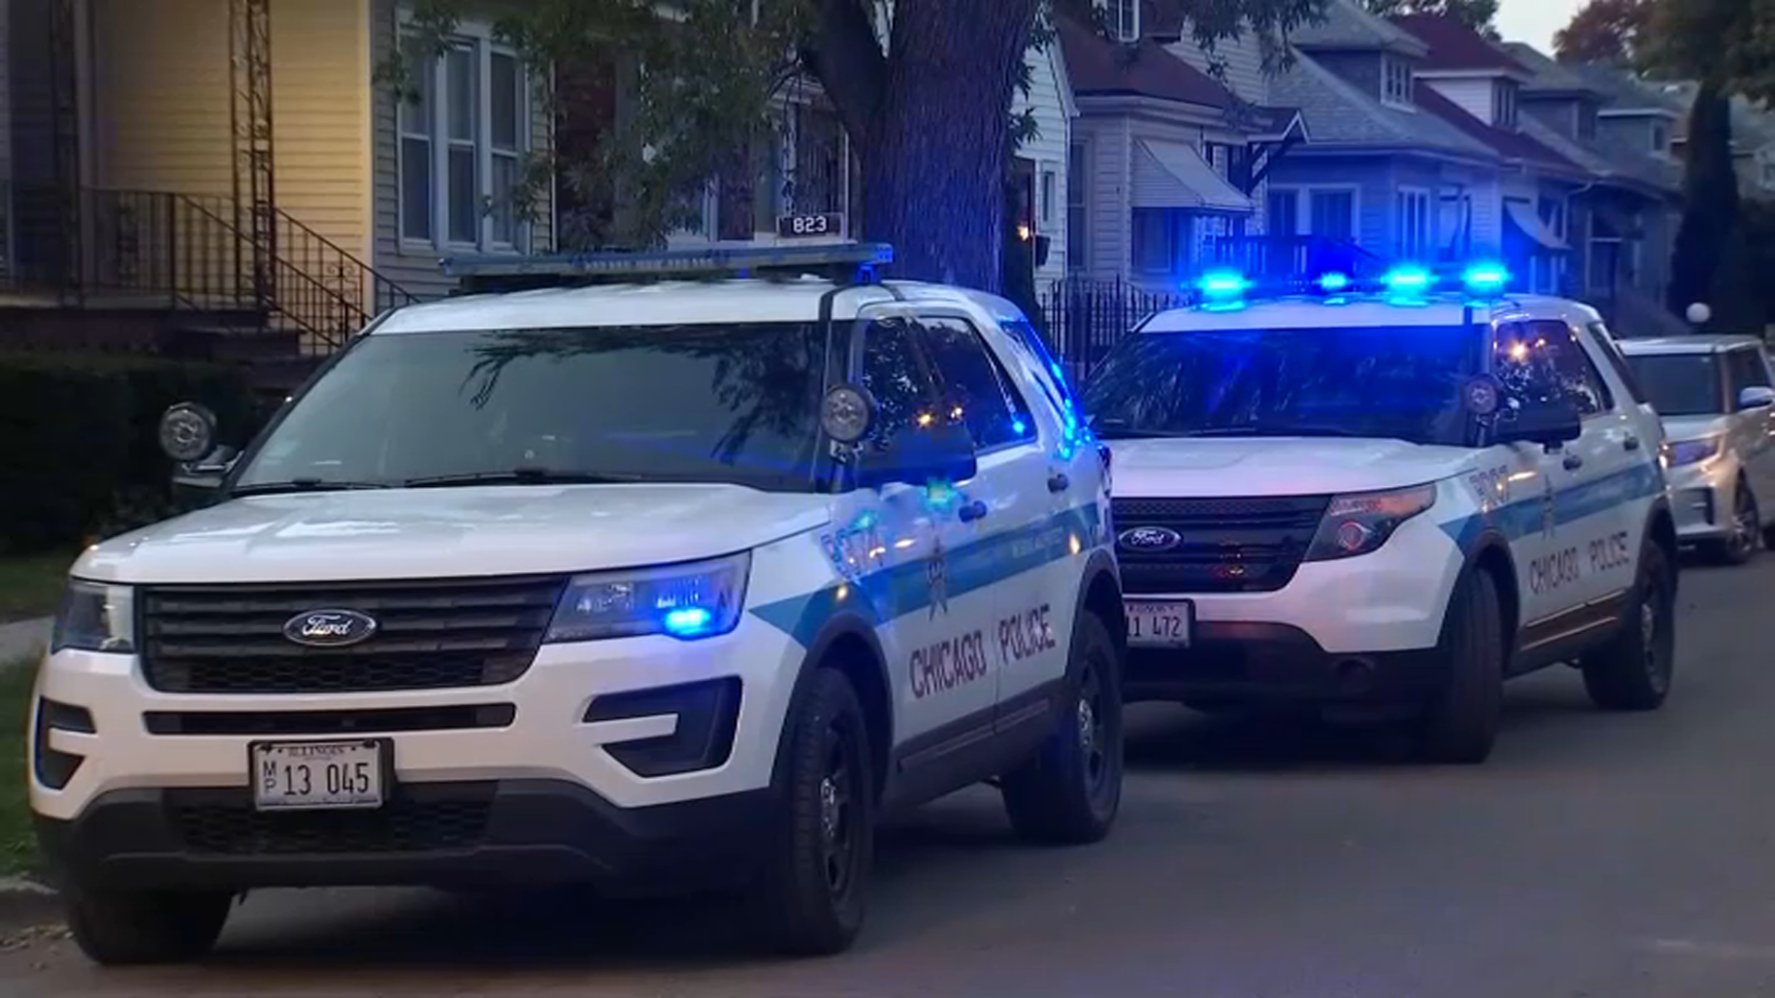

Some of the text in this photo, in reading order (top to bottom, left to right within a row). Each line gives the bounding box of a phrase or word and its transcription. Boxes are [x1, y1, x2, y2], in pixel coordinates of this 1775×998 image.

[793, 215, 827, 233] 823
[1131, 529, 1165, 545] Ford
[1529, 531, 1629, 595] CHICAGO POLICE
[302, 614, 353, 636] Ford
[1153, 615, 1182, 637] 472
[909, 603, 1055, 699] CHICAGO POLICE
[284, 764, 312, 796] 13
[326, 762, 369, 795] 045
